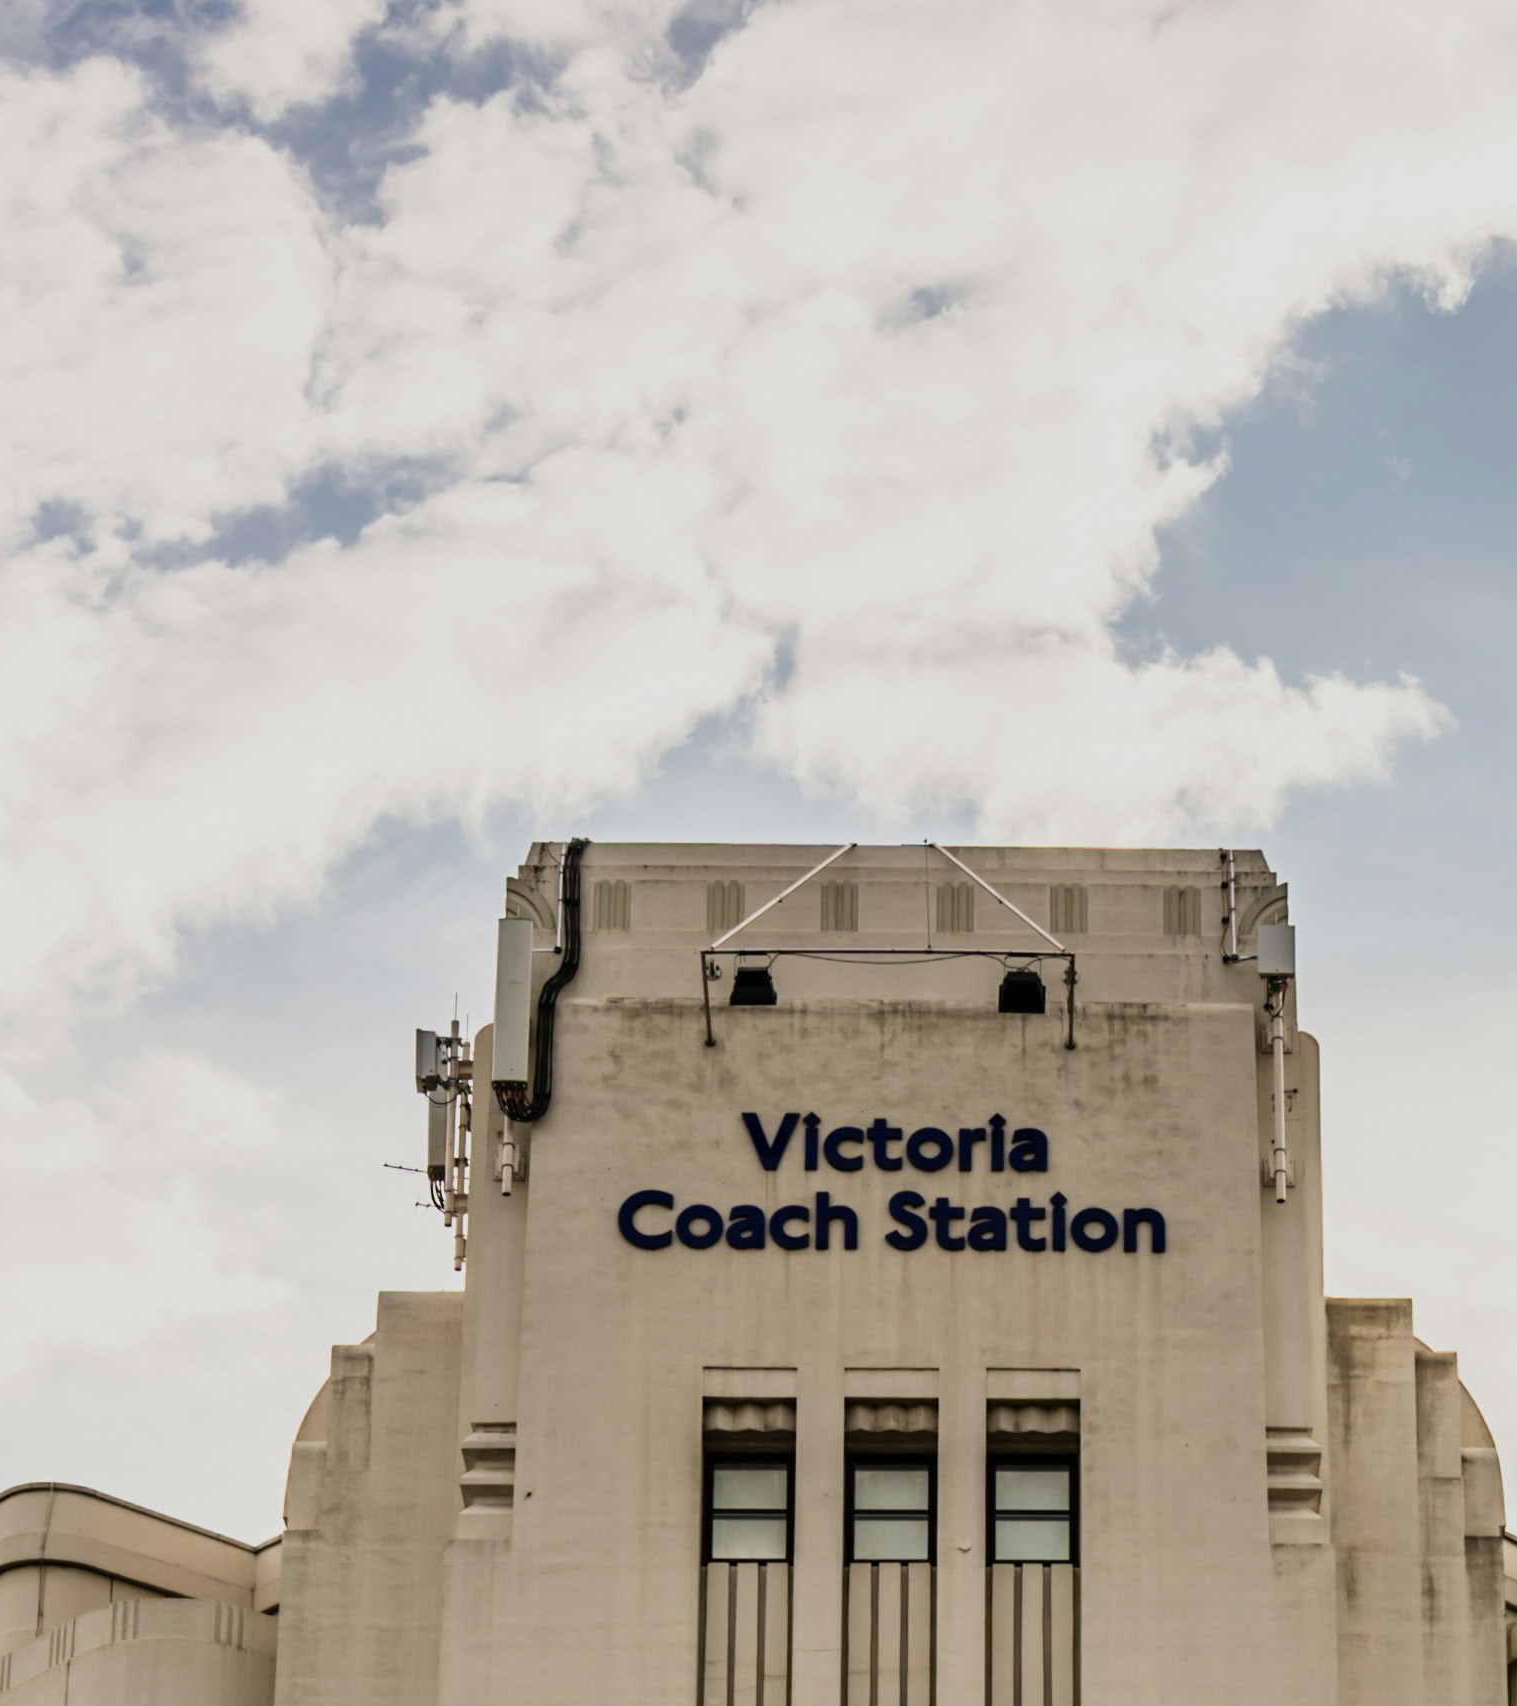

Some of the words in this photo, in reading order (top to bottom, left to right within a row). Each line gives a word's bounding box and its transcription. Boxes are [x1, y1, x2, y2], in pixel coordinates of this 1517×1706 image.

[742, 1112, 1049, 1173] Victoria
[617, 1189, 859, 1251] Coach
[884, 1190, 1166, 1253] Station
